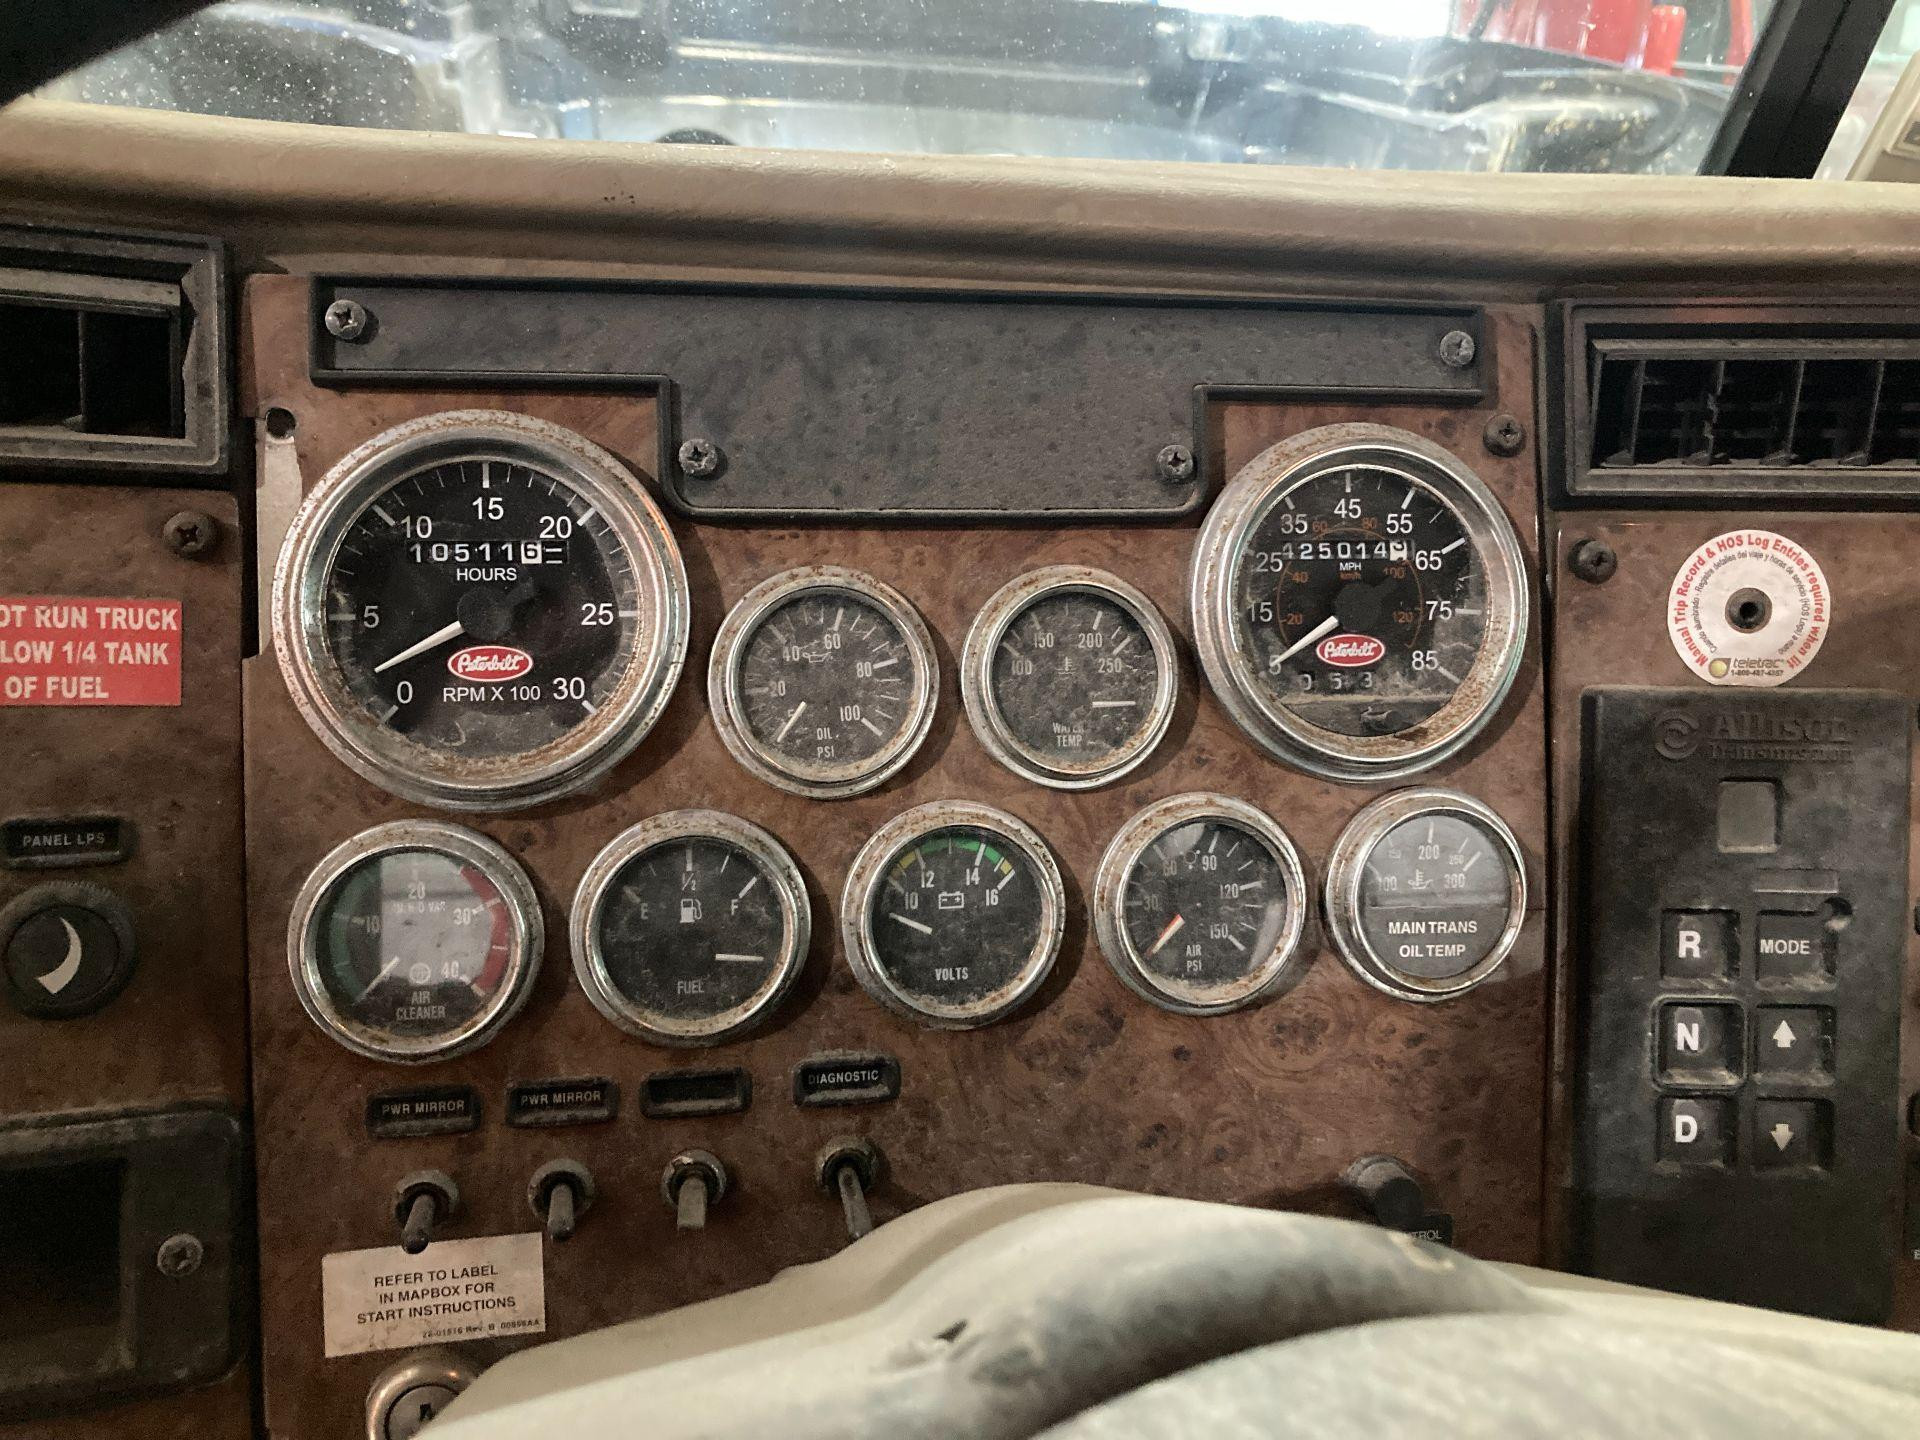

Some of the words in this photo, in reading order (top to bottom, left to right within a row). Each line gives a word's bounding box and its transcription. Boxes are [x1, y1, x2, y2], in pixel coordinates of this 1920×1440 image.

[472, 497, 504, 520] 15
[1333, 498, 1362, 519] 45
[400, 515, 433, 539] 10
[539, 515, 572, 539] 20
[1281, 514, 1308, 534] 35
[1386, 513, 1413, 533] 55
[1716, 535, 1744, 552] HOS
[1748, 534, 1769, 550] Log
[1415, 550, 1442, 571] 65
[1705, 547, 1716, 559] &
[1772, 538, 1810, 571] Entries
[1255, 551, 1283, 573] 25
[1339, 562, 1362, 571] MPH
[456, 568, 518, 581] HOURS
[1676, 556, 1706, 597] Record
[1806, 571, 1826, 623] required
[35, 605, 87, 629] RUN
[95, 607, 178, 631] TRUCK
[363, 606, 380, 628] 5
[581, 602, 615, 626] 25
[1250, 601, 1273, 623] 15
[1425, 600, 1452, 621] 75
[1674, 600, 1689, 625] Trip
[824, 633, 841, 650] 60
[1033, 632, 1054, 648] 150
[1078, 633, 1103, 648] 200
[1676, 626, 1709, 667] Manual
[1798, 626, 1821, 656] when
[62, 641, 97, 664] 1/4
[104, 642, 169, 665] TANK
[782, 645, 800, 662] 40
[1324, 642, 1378, 659] Peterbilt
[457, 653, 524, 673] Peterbilt
[1011, 659, 1033, 676] 100
[1098, 657, 1122, 673] 250
[1268, 655, 1282, 675] 5
[1411, 650, 1439, 671] 85
[1733, 658, 1779, 668] teletrac
[856, 661, 873, 678] 80
[4, 675, 38, 699] OF
[46, 676, 110, 699] FUEL
[396, 681, 413, 704] 0
[443, 686, 485, 702] RPM
[490, 686, 504, 701] X
[510, 685, 541, 701] 100
[552, 677, 585, 700] 30
[839, 705, 861, 721] 100
[816, 727, 833, 740] OIL
[1056, 735, 1083, 747] TEMP
[817, 746, 835, 758] PSI
[22, 833, 72, 847] PANEL
[77, 832, 105, 845] LPS
[1418, 845, 1440, 860] 200
[1202, 855, 1217, 871] 90
[921, 871, 935, 888] 12
[965, 867, 980, 886] 14
[1443, 873, 1465, 889] 300
[408, 881, 426, 900] 20
[985, 889, 999, 906] 16
[1220, 883, 1239, 899] 120
[731, 899, 739, 916] F
[905, 892, 919, 910] 10
[453, 908, 471, 925] 30
[640, 903, 649, 920] E
[1210, 923, 1228, 939] 150
[1388, 922, 1426, 935] MAIN
[1428, 921, 1478, 934] TRANS
[1186, 944, 1202, 957] AIR
[1399, 945, 1423, 958] OIL
[1426, 944, 1466, 957] TEMP
[1678, 931, 1701, 958] R
[1760, 939, 1810, 954] MODE
[441, 961, 460, 978] 40
[935, 967, 969, 981] VOLTS
[1186, 960, 1202, 972] PSI
[677, 981, 705, 995] FUEL
[411, 991, 431, 1004] AIR
[396, 1006, 446, 1021] CLEANER
[1676, 1023, 1699, 1051] N
[808, 1070, 879, 1084] DIAGNOSTIC
[520, 1094, 548, 1106] PWR
[552, 1090, 601, 1104] MIRROR
[381, 1103, 410, 1115] PWR
[415, 1100, 465, 1113] MIRROR
[1675, 1115, 1698, 1143] D
[374, 1272, 423, 1288] REFER
[428, 1270, 447, 1281] TO
[451, 1265, 499, 1279] LABEL
[379, 1293, 394, 1304] IN
[400, 1285, 460, 1301] MAPBOX
[465, 1282, 495, 1294] FOR
[358, 1308, 404, 1324] START
[409, 1297, 516, 1317] INSTRUCTIONS
